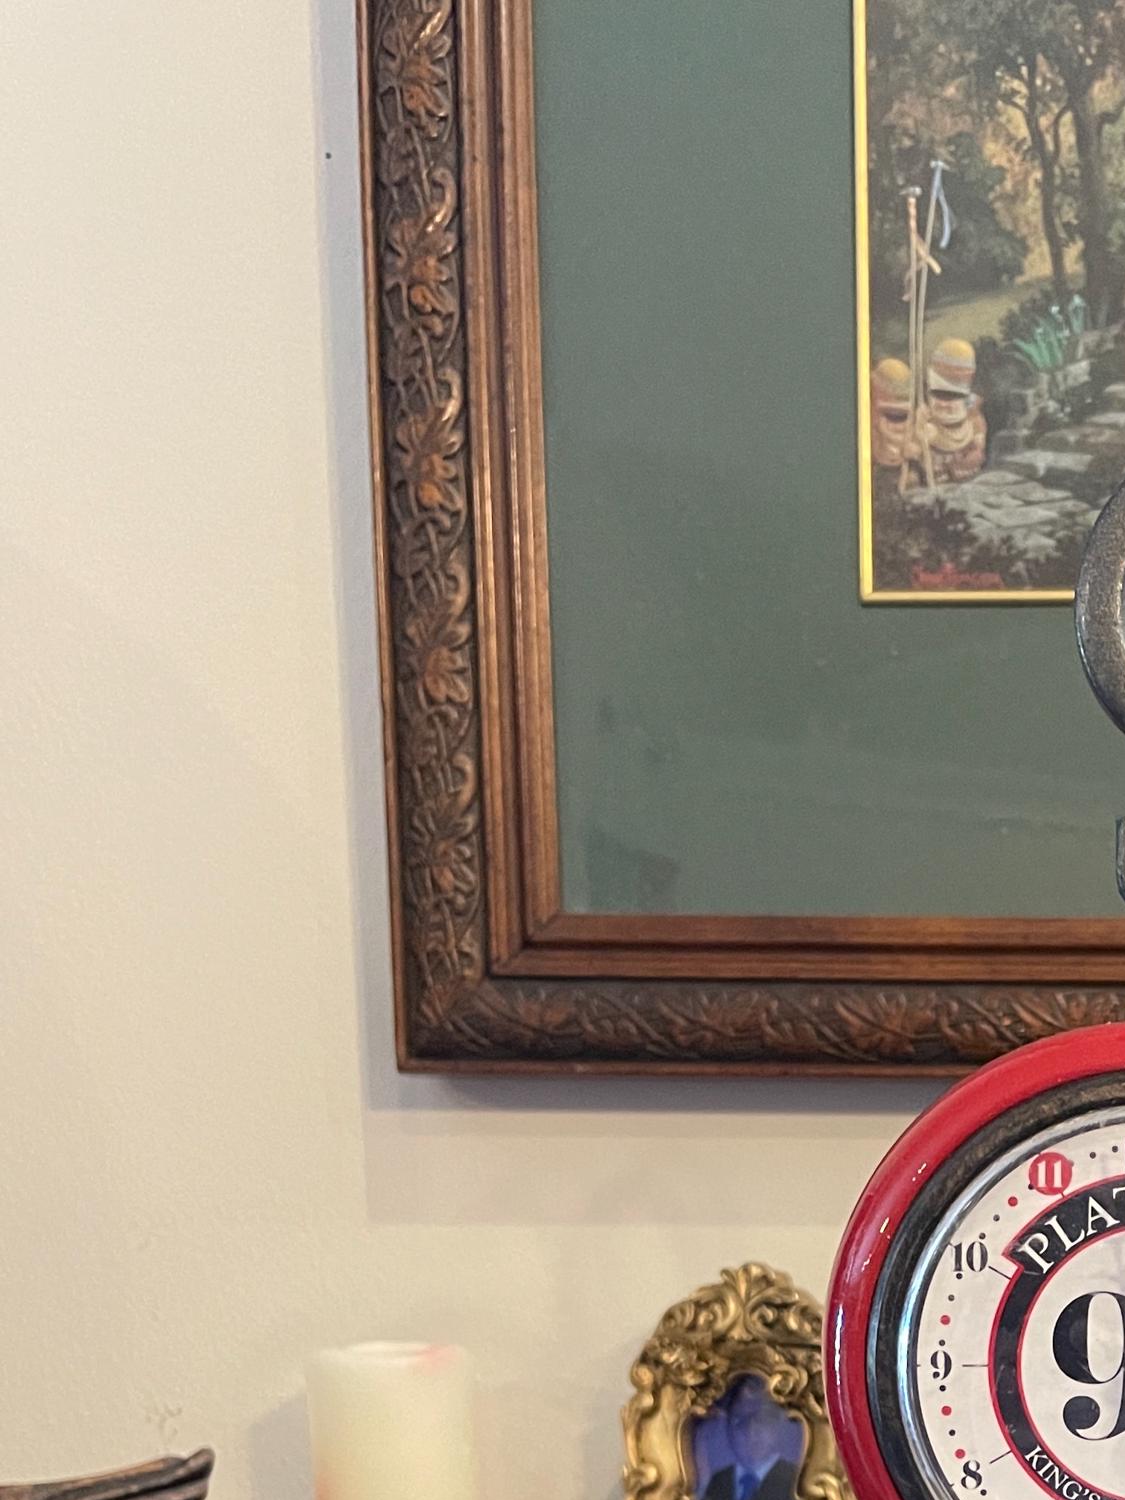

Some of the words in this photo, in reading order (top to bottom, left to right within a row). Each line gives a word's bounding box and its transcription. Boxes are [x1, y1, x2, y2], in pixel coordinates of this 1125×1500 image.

[1036, 1161, 1064, 1188] 11
[952, 1241, 988, 1272] 10
[930, 1350, 952, 1380] 9
[961, 1460, 982, 1490] 8
